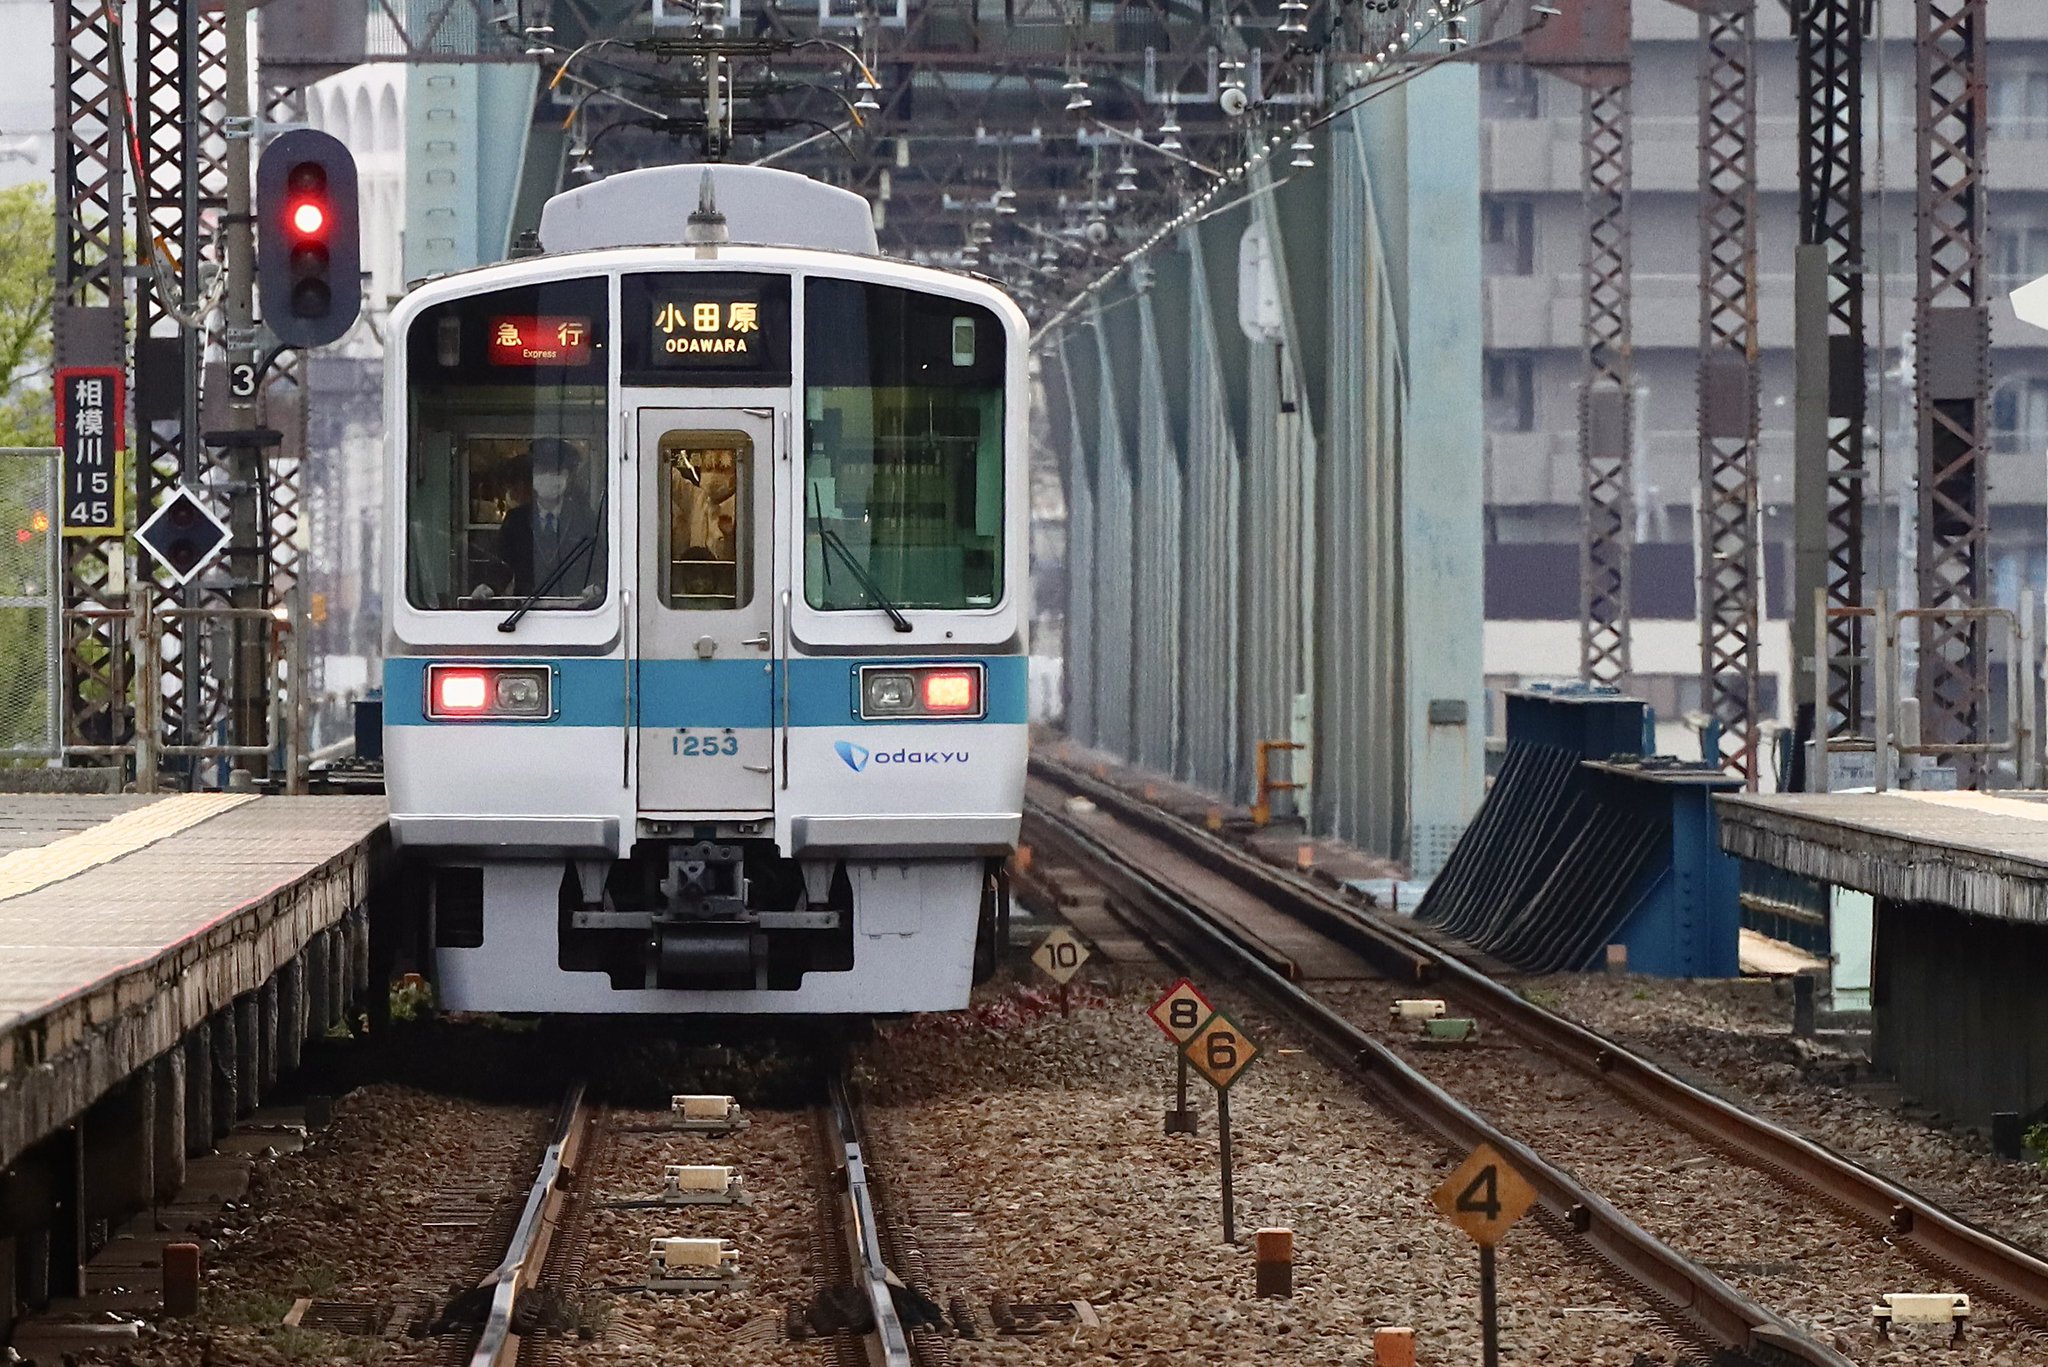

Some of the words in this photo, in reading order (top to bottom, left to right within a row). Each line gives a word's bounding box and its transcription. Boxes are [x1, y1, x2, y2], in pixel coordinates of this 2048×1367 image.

[655, 302, 759, 333] 小田原
[496, 322, 583, 346] 急行
[665, 338, 747, 353] ODAWARA
[523, 349, 557, 359] Express
[232, 364, 255, 396] 3
[75, 379, 103, 466] 相模川
[76, 472, 108, 494] 15
[70, 501, 108, 523] 45
[672, 736, 738, 756] 1253
[875, 748, 969, 764] odakyu
[1045, 942, 1077, 969] 10
[1170, 998, 1198, 1028] 8
[1207, 1031, 1237, 1069] 6
[1456, 1164, 1501, 1221] 4
